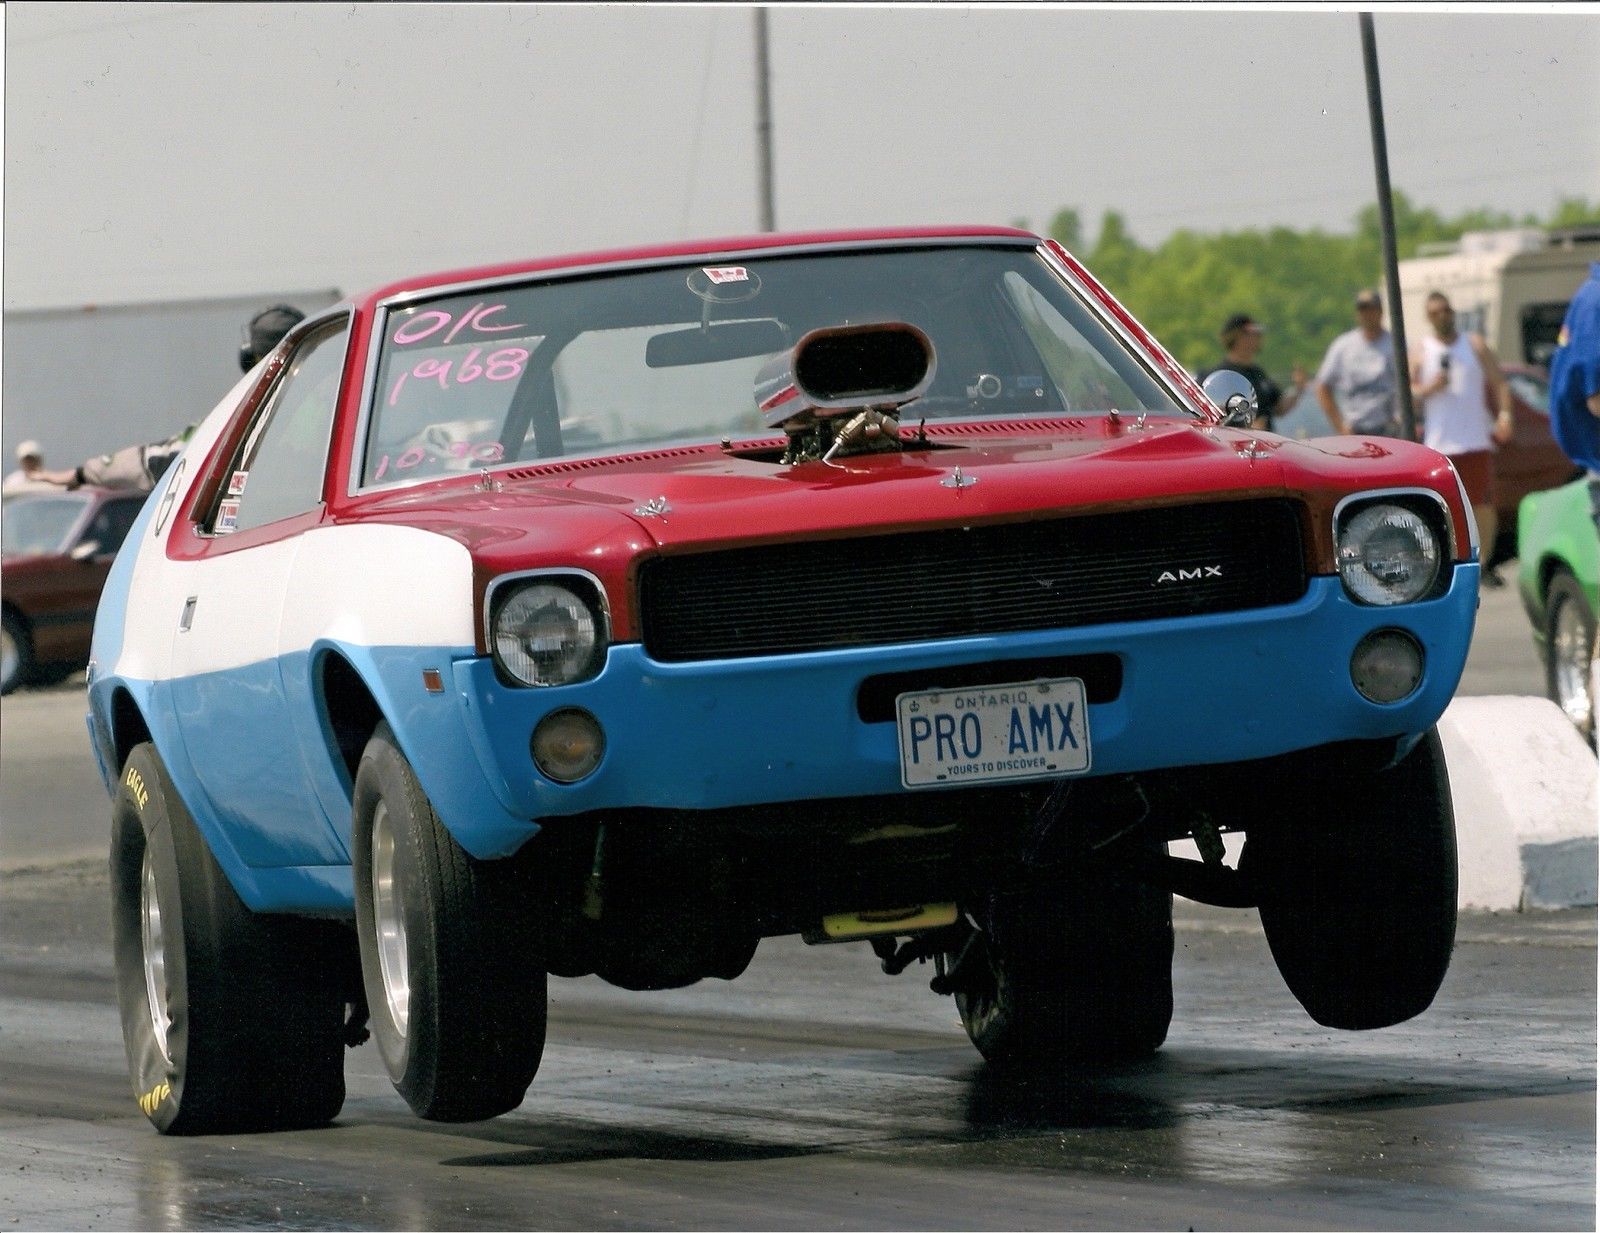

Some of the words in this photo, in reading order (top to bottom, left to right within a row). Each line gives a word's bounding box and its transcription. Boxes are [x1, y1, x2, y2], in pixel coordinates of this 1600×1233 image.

[389, 348, 529, 406] 1968
[1157, 564, 1223, 583] AMX
[954, 691, 1028, 710] ONTARIO
[909, 712, 982, 764] PRO
[1008, 701, 1080, 755] AMX
[947, 763, 980, 776] YOURS
[982, 761, 995, 772] TO
[996, 757, 1047, 772] DISCOVER
[126, 767, 149, 811] EAGLE
